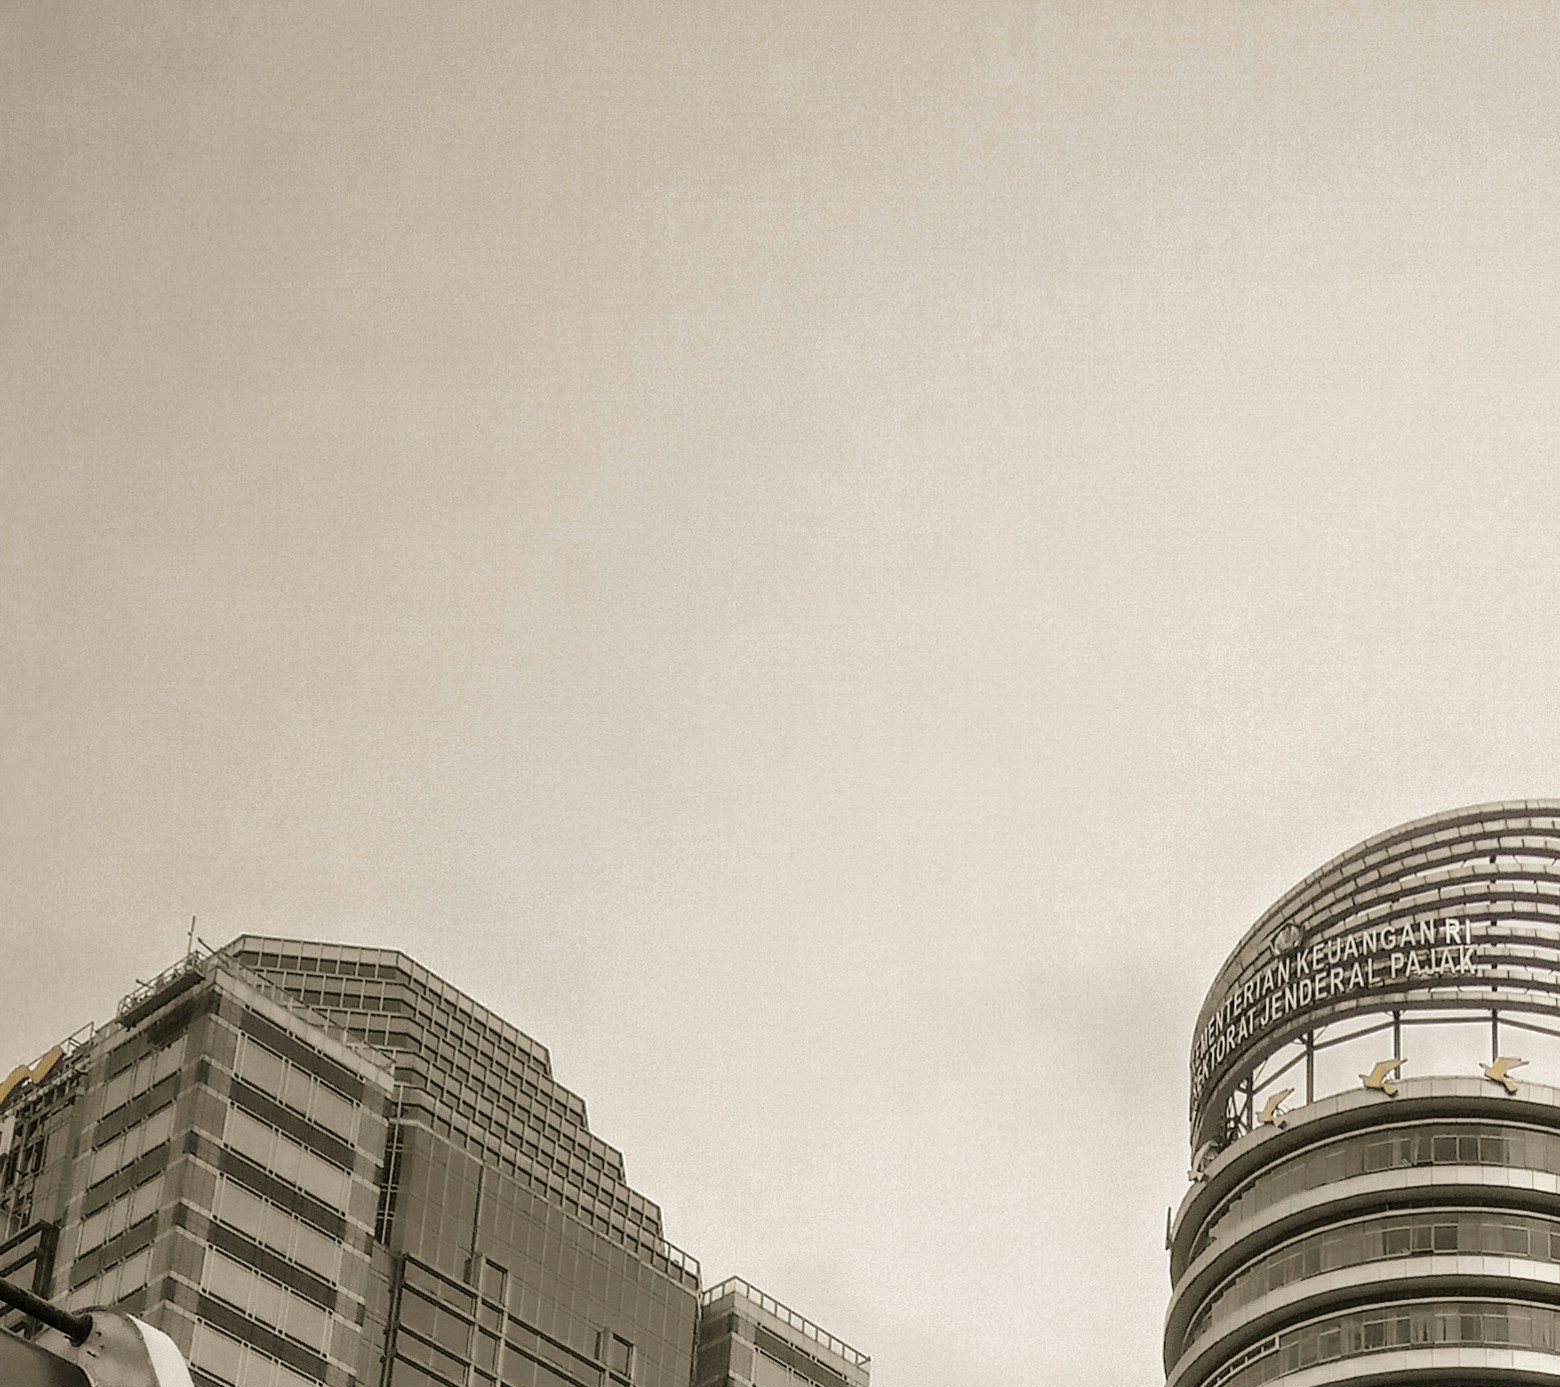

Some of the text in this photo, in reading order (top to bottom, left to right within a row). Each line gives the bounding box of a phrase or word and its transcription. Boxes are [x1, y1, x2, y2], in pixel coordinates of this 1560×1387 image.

[1296, 918, 1436, 978] KEUANGAN
[1445, 918, 1471, 945] RI
[1261, 957, 1381, 1027] JENDERAL
[1390, 947, 1477, 979] PAJAK
